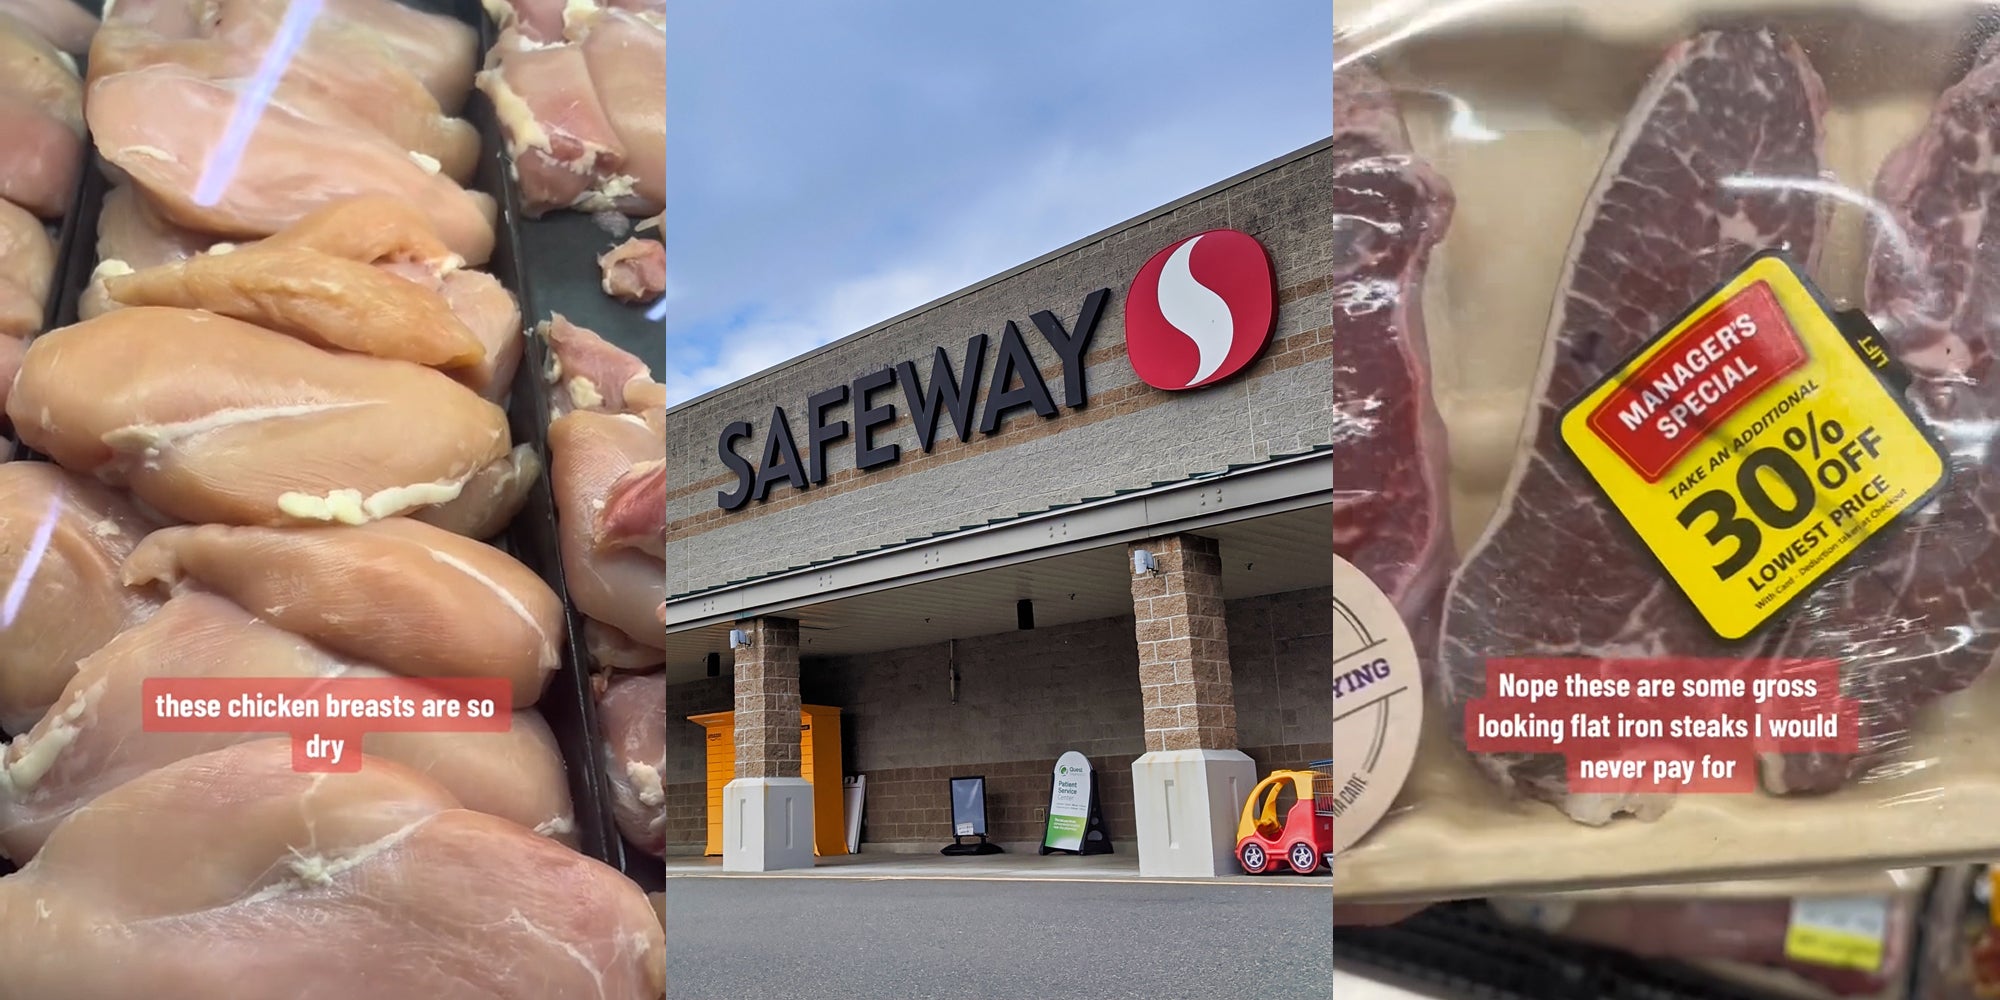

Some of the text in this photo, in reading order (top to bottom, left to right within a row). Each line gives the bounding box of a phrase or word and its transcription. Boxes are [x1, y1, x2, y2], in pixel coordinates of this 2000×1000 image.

[717, 287, 1112, 510] SAFEWAY
[1618, 313, 1757, 431] MANAGER'S
[1656, 356, 1758, 439] SPECIAL
[1857, 336, 1889, 368] LIFT
[1669, 380, 1819, 500] TAKE AN ADDITIONAL
[1817, 426, 1882, 490] OFF
[1676, 410, 1845, 582] 30%
[1747, 475, 1890, 592] LOWEST PRICE
[1755, 592, 1776, 610] With
[1776, 577, 1795, 594] Card
[1799, 543, 1839, 576] Deduction
[1838, 523, 1862, 545] taken
[1860, 516, 1870, 527] at
[1871, 488, 1907, 519] Checkout
[1058, 780, 1077, 788] Patient
[1058, 787, 1077, 795] Service
[1338, 772, 1368, 805] CARE
